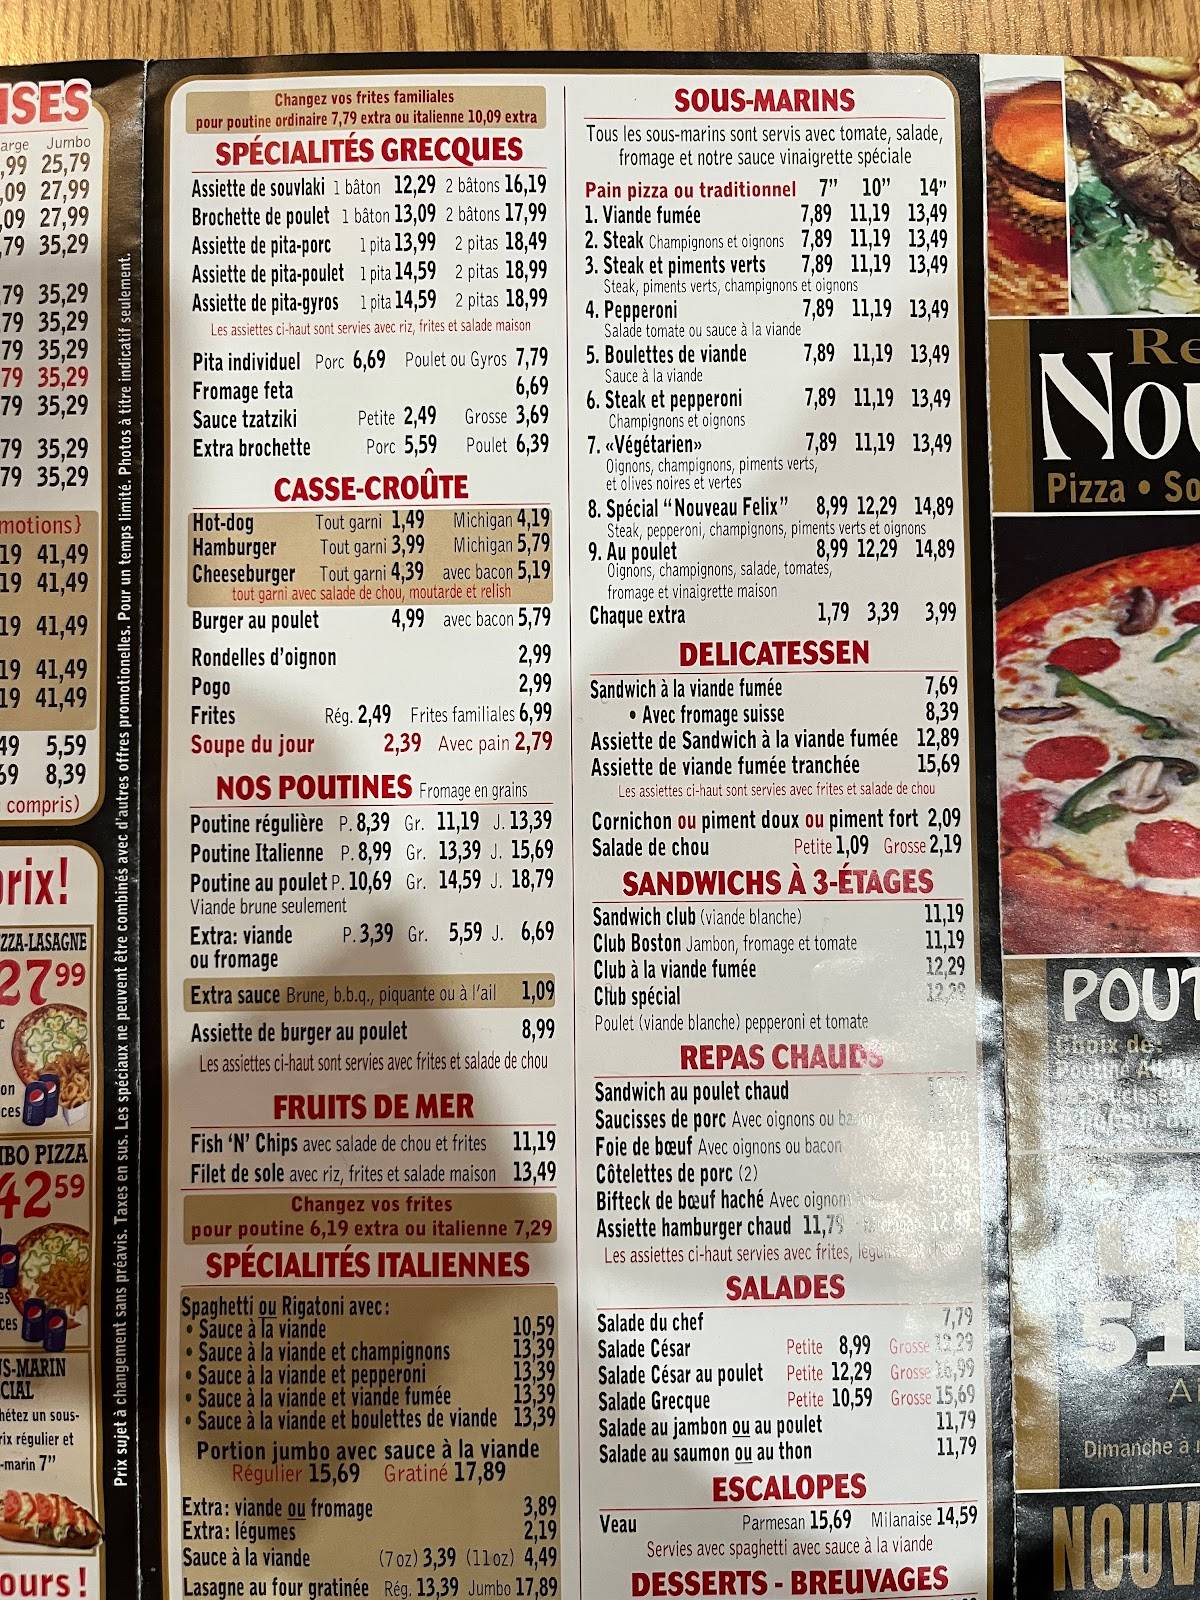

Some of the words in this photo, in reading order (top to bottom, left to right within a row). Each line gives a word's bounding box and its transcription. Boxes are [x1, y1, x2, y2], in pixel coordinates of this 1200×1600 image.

[274, 92, 327, 108] Changez
[331, 94, 353, 105] vos
[356, 90, 390, 104] frites
[393, 89, 455, 104] familiales
[674, 87, 856, 113] SOUS-MARINS
[195, 118, 224, 132] pour
[226, 115, 272, 132] poutine
[275, 111, 328, 127] ordinaire
[331, 110, 357, 128] 7,79
[360, 110, 391, 125] extra
[395, 113, 410, 124] ou
[413, 109, 464, 124] italienne
[468, 109, 502, 127] 10,09
[504, 109, 538, 125] extra
[585, 124, 619, 143] Tous
[623, 124, 642, 143] les
[646, 125, 726, 143] sous-marins
[730, 126, 758, 142] sont
[762, 124, 801, 142] servis
[805, 128, 836, 142] avec
[839, 124, 892, 145] tomate,
[896, 123, 943, 145] salade,
[46, 136, 91, 150] Jumbo
[215, 131, 375, 167] SPÉCIALITÉS
[380, 136, 524, 168] GRECQUES
[41, 152, 91, 176] 25,79
[191, 178, 246, 198] Assiette
[250, 178, 266, 197] de
[270, 176, 325, 197] souvlaki
[333, 180, 340, 196] 1
[345, 178, 381, 195] bâton
[394, 174, 436, 199] 12,29
[445, 178, 453, 194] 2
[458, 176, 500, 193] bâtons
[504, 173, 547, 198] 16,19
[584, 204, 598, 224] 1.
[602, 204, 652, 224] Viande
[656, 204, 701, 224] fumée
[800, 203, 832, 227] 7,89
[850, 202, 890, 227] 11,19
[908, 202, 948, 227] 13,49
[117, 252, 132, 324] seulement.
[211, 323, 228, 337] Les
[231, 322, 274, 337] assiettes
[276, 321, 311, 336] ci-haut
[313, 323, 335, 336] sont
[337, 323, 371, 336] servies
[373, 323, 396, 335] avec
[399, 322, 416, 337] riz,
[419, 318, 445, 334] frites
[447, 319, 458, 333] et
[460, 318, 493, 333] salade
[495, 321, 531, 333] maison
[604, 322, 642, 338] Salade
[645, 323, 685, 338] tomate
[688, 326, 702, 338] ou
[706, 325, 737, 337] sauce
[740, 322, 749, 337] à
[751, 322, 763, 337] la
[765, 321, 802, 336] viande
[117, 327, 132, 382] indicatif
[117, 386, 132, 415] titre
[117, 418, 132, 426] à
[117, 429, 132, 476] Photos
[273, 467, 469, 503] CASSE-CROÛTE
[1048, 472, 1126, 504] Pizza
[117, 479, 132, 521] limité.
[192, 507, 254, 535] Hot-dog
[315, 514, 345, 530] Tout
[349, 517, 382, 533] garni
[392, 509, 425, 534] 1,49
[453, 511, 513, 531] Michigan
[516, 507, 551, 532] 4,19
[37, 543, 89, 567] 41,49
[117, 525, 135, 566] temps
[120, 569, 132, 586] un
[117, 589, 132, 621] Pour
[679, 639, 870, 667] DELICATESSEN
[116, 625, 133, 728] promotionelles.
[590, 678, 656, 700] Sandwich
[660, 678, 669, 698] à
[673, 678, 686, 698] la
[689, 678, 734, 698] viande
[739, 677, 783, 697] fumée
[925, 675, 958, 699] 7,69
[46, 734, 87, 758] 5,59
[115, 731, 130, 772] offres
[45, 763, 87, 788] 8,39
[216, 774, 272, 801] NOS
[278, 773, 413, 800] POUTINES
[419, 782, 471, 799] Fromage
[474, 785, 488, 798] en
[492, 785, 528, 801] grains
[7, 794, 81, 815] compris)
[115, 775, 130, 830] d'autres
[190, 813, 250, 834] Poutine
[255, 812, 324, 837] régulière
[339, 815, 353, 832] P.
[356, 811, 390, 836] 8,39
[404, 814, 425, 832] Gr.
[437, 810, 480, 835] 11,19
[492, 813, 505, 831] J.
[510, 809, 552, 834] 13,39
[117, 834, 129, 864] avec
[622, 869, 782, 897] SANDWICHS
[787, 862, 807, 895] À
[812, 861, 934, 896] 3-ÉTAGES
[114, 867, 129, 932] combinés
[113, 936, 128, 963] être
[593, 932, 626, 953] Club
[631, 932, 682, 953] Boston
[685, 935, 739, 955] Jambon,
[742, 934, 794, 954] fromage
[798, 938, 811, 951] et
[814, 935, 857, 951] tomate
[925, 929, 965, 954] 11,19
[113, 966, 131, 1021] peuvent
[117, 1024, 128, 1041] ne
[680, 1043, 765, 1071] REPAS
[771, 1043, 884, 1070] CHAUDS
[114, 1044, 132, 1103] spéciaux
[594, 1080, 666, 1103] Sandwich
[670, 1085, 688, 1102] au
[693, 1080, 740, 1104] poulet
[745, 1079, 789, 1101] chaud
[114, 1106, 129, 1130] Les
[273, 1093, 367, 1121] FRUITS
[374, 1093, 410, 1120] DE
[415, 1092, 475, 1119] MER
[117, 1134, 129, 1161] sus.
[117, 1165, 129, 1182] en
[113, 1185, 129, 1225] Taxes
[112, 1229, 130, 1283] préavis.
[206, 1244, 371, 1279] SPÉCIALITÉS
[378, 1251, 530, 1278] ITALIENNES
[726, 1273, 846, 1302] SALADES
[115, 1287, 127, 1318] sans
[112, 1321, 130, 1405] changement
[112, 1409, 127, 1418] à
[113, 1421, 130, 1455] sujet
[1084, 1438, 1173, 1459] Dimanche
[113, 1459, 128, 1487] Prix
[712, 1472, 867, 1502] ESCALOPES
[599, 1514, 637, 1534] Veau
[742, 1513, 807, 1533] Parmesan
[808, 1508, 853, 1534] 15,69
[871, 1511, 933, 1529] Milanaise
[936, 1504, 978, 1529] 14,59
[631, 1570, 768, 1597] DESSERTS
[791, 1564, 949, 1596] BREUVAGES
